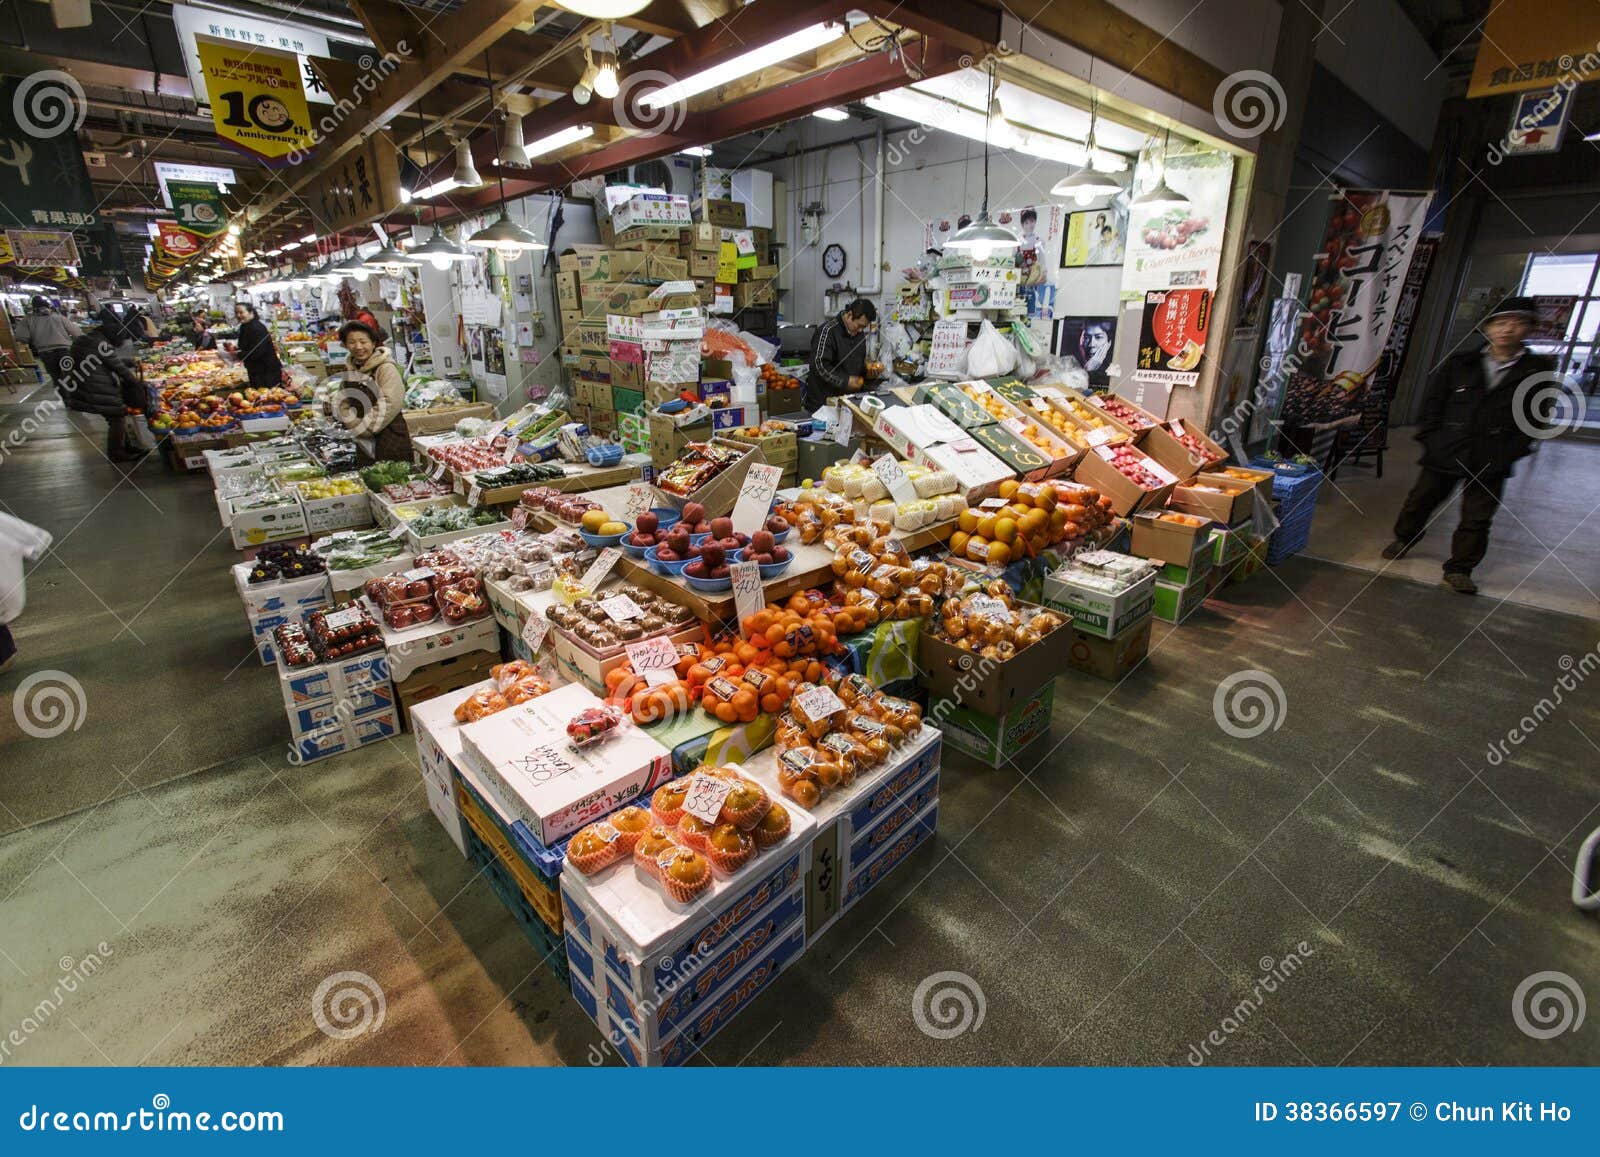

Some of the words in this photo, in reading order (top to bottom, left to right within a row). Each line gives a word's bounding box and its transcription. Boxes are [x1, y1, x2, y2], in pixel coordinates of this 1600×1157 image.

[236, 128, 300, 145] Anniversary
[31, 209, 96, 225] 青果通り
[645, 209, 685, 219] はくさい
[1325, 243, 1384, 376] コーヒー
[1372, 224, 1412, 337] スペシャルティ
[694, 920, 774, 996] デコポン
[699, 959, 775, 1035] デコポン
